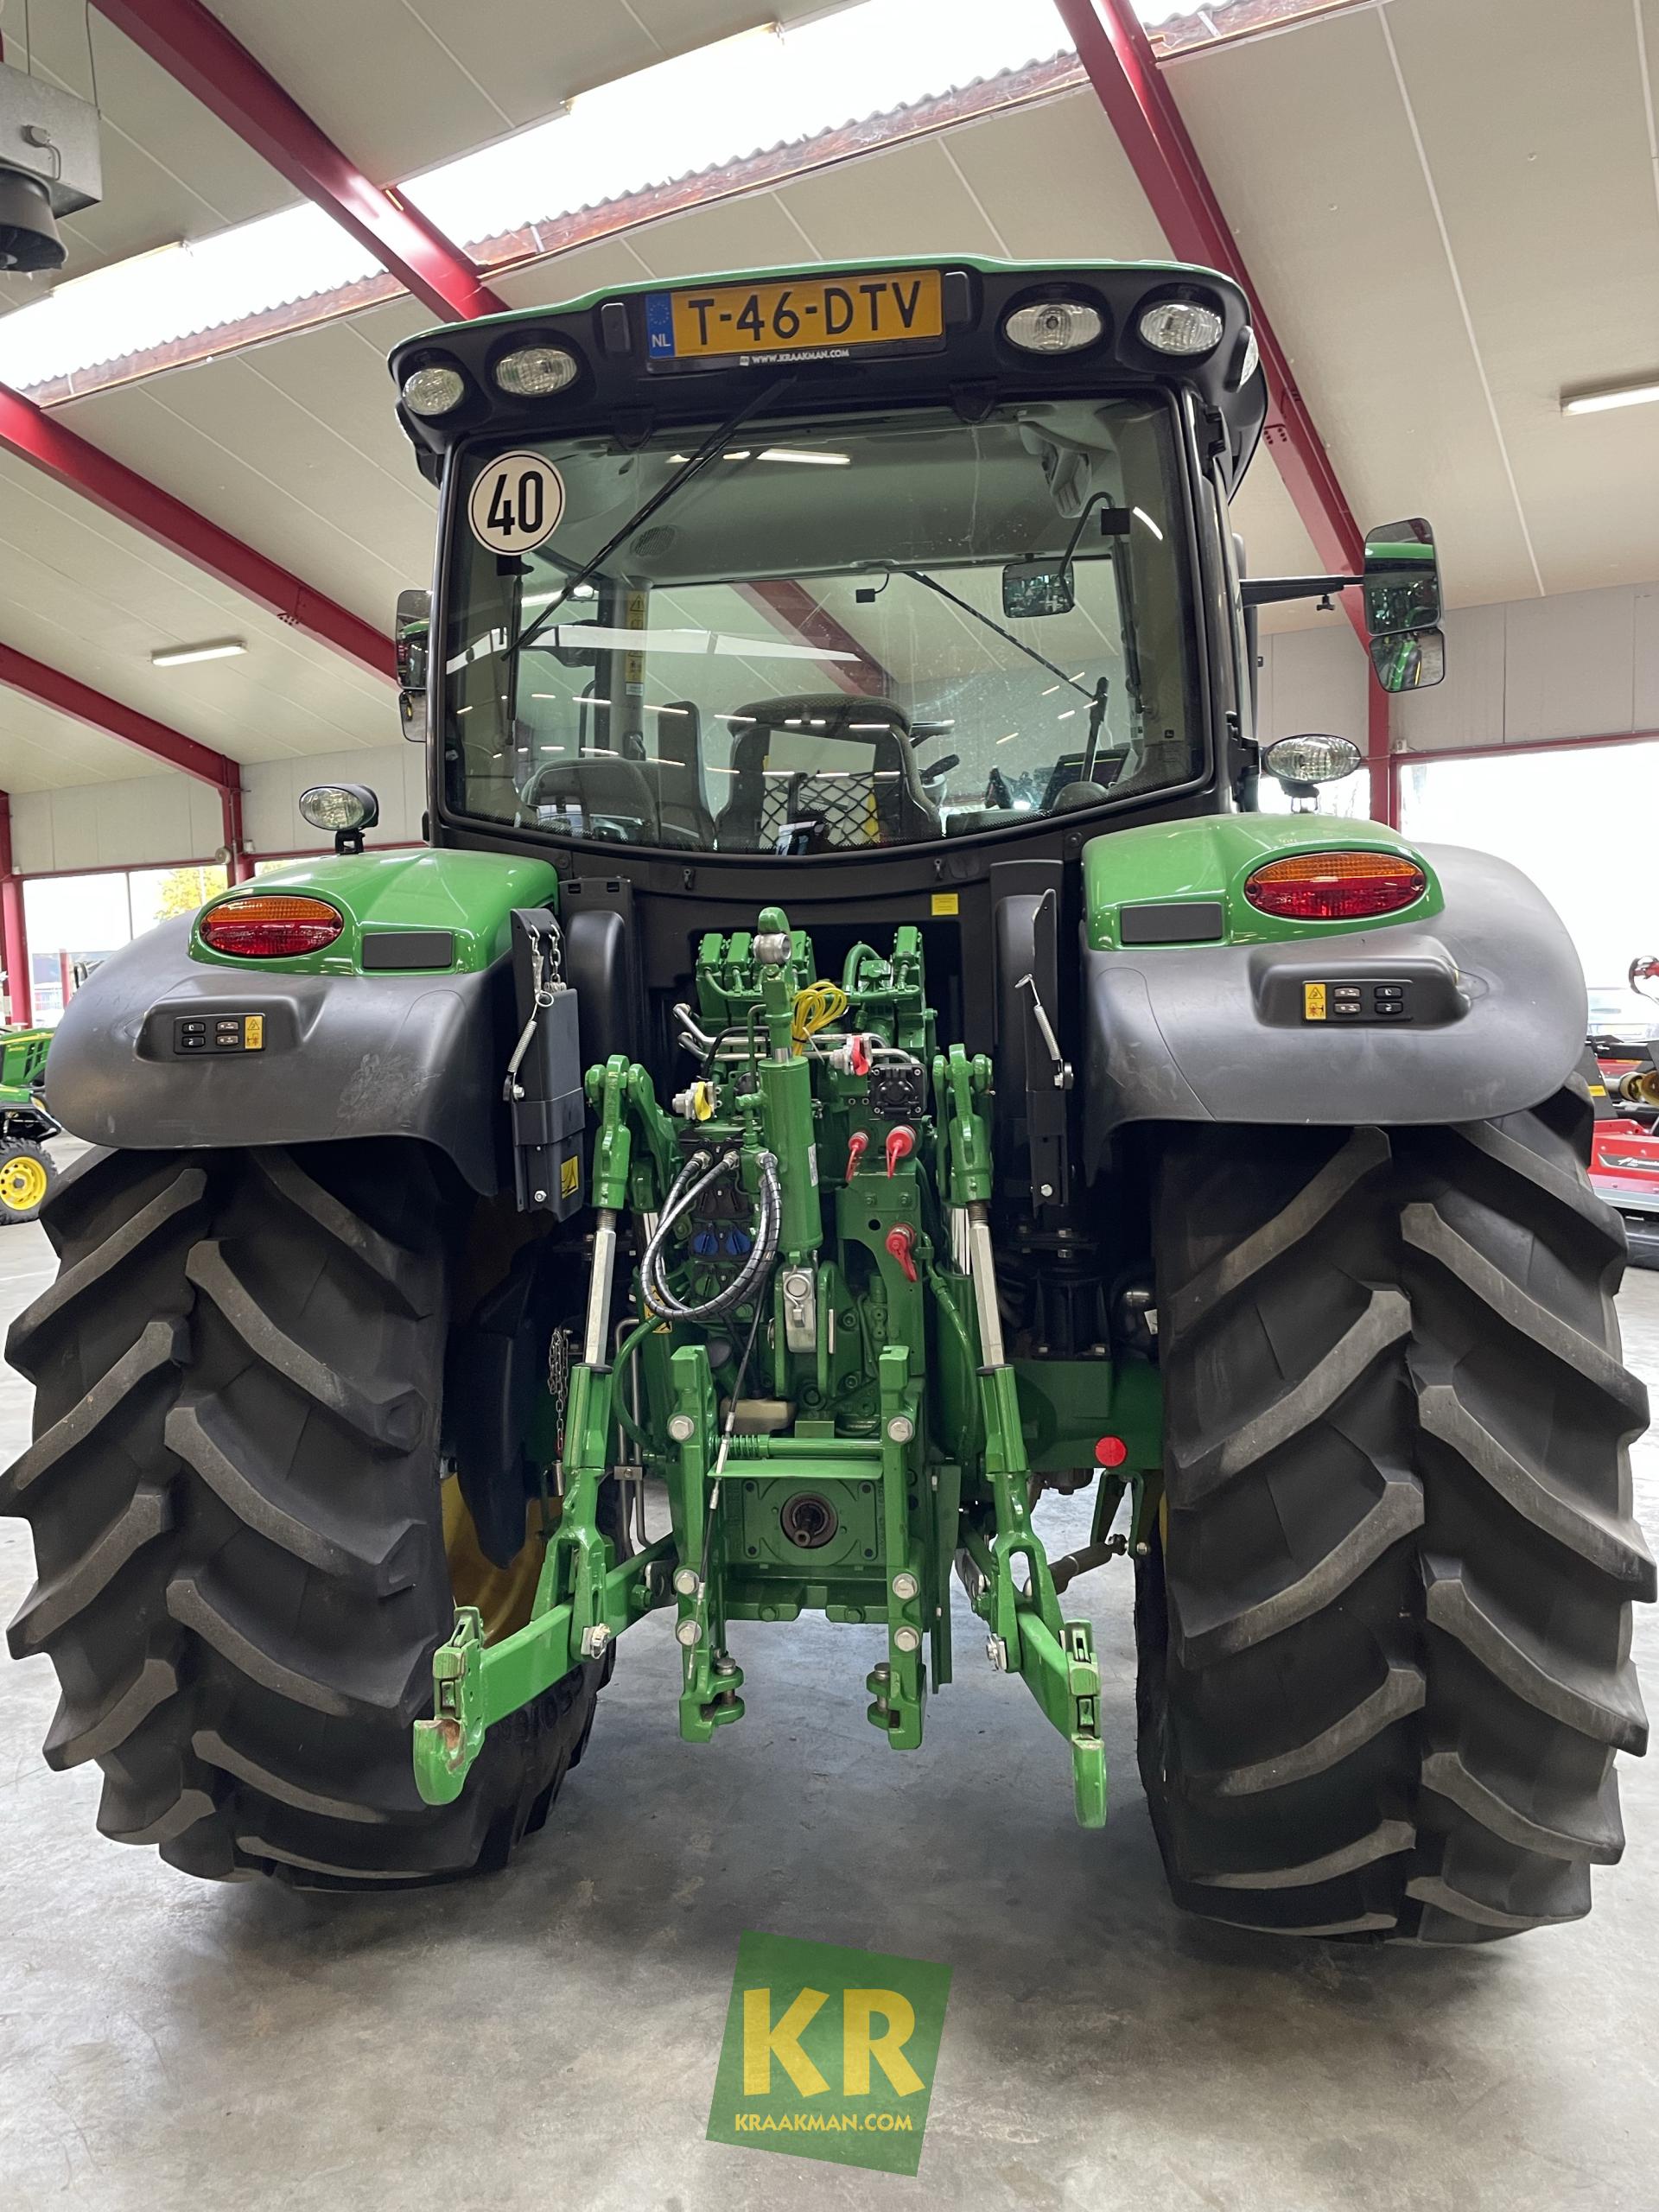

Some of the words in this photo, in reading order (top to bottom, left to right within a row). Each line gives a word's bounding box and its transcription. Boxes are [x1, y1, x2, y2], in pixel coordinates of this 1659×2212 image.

[688, 280, 921, 346] T-46-DTV
[652, 334, 671, 347] NL
[752, 349, 849, 364] WWW.KRAAKMAN.COM
[486, 470, 543, 536] 40
